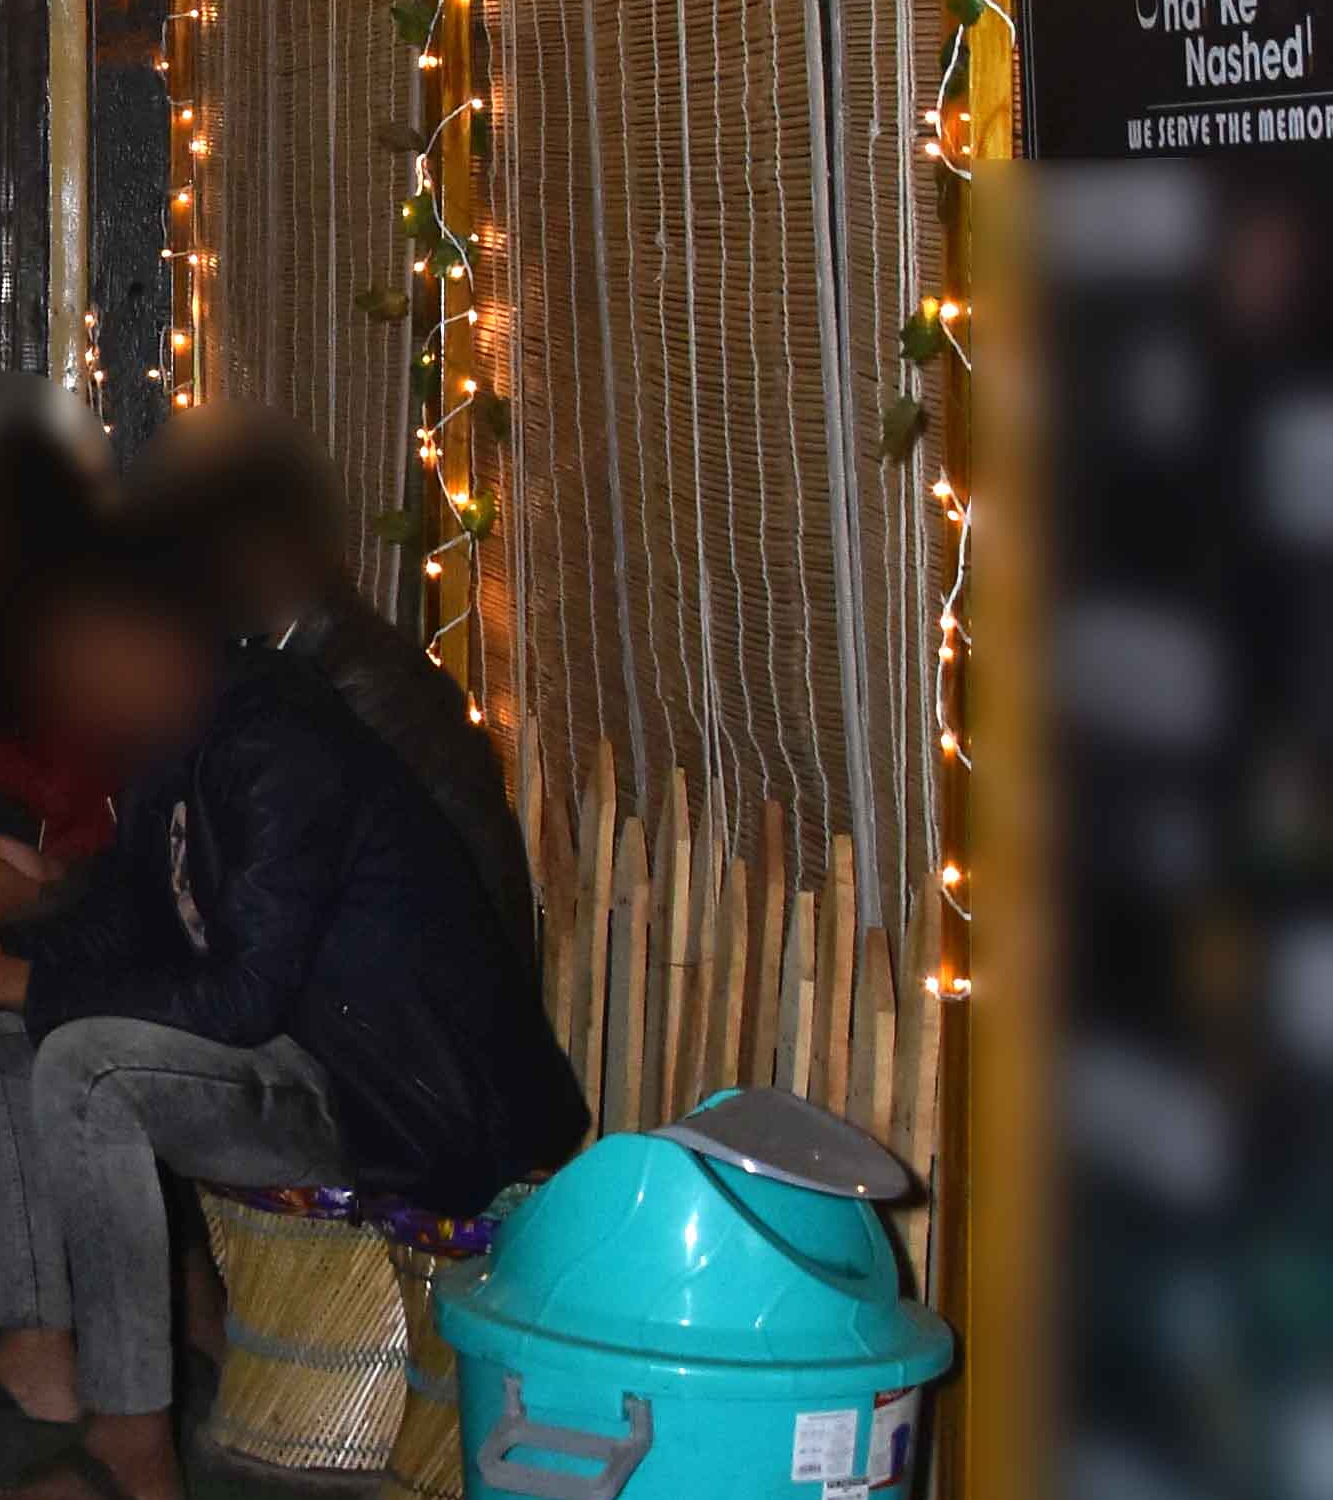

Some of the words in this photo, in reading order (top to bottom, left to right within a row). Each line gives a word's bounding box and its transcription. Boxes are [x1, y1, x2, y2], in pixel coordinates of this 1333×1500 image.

[1127, 119, 1153, 150] WE
[1158, 114, 1211, 148] SERVE
[1215, 112, 1252, 145] THE
[1258, 105, 1333, 142] MEMOR
